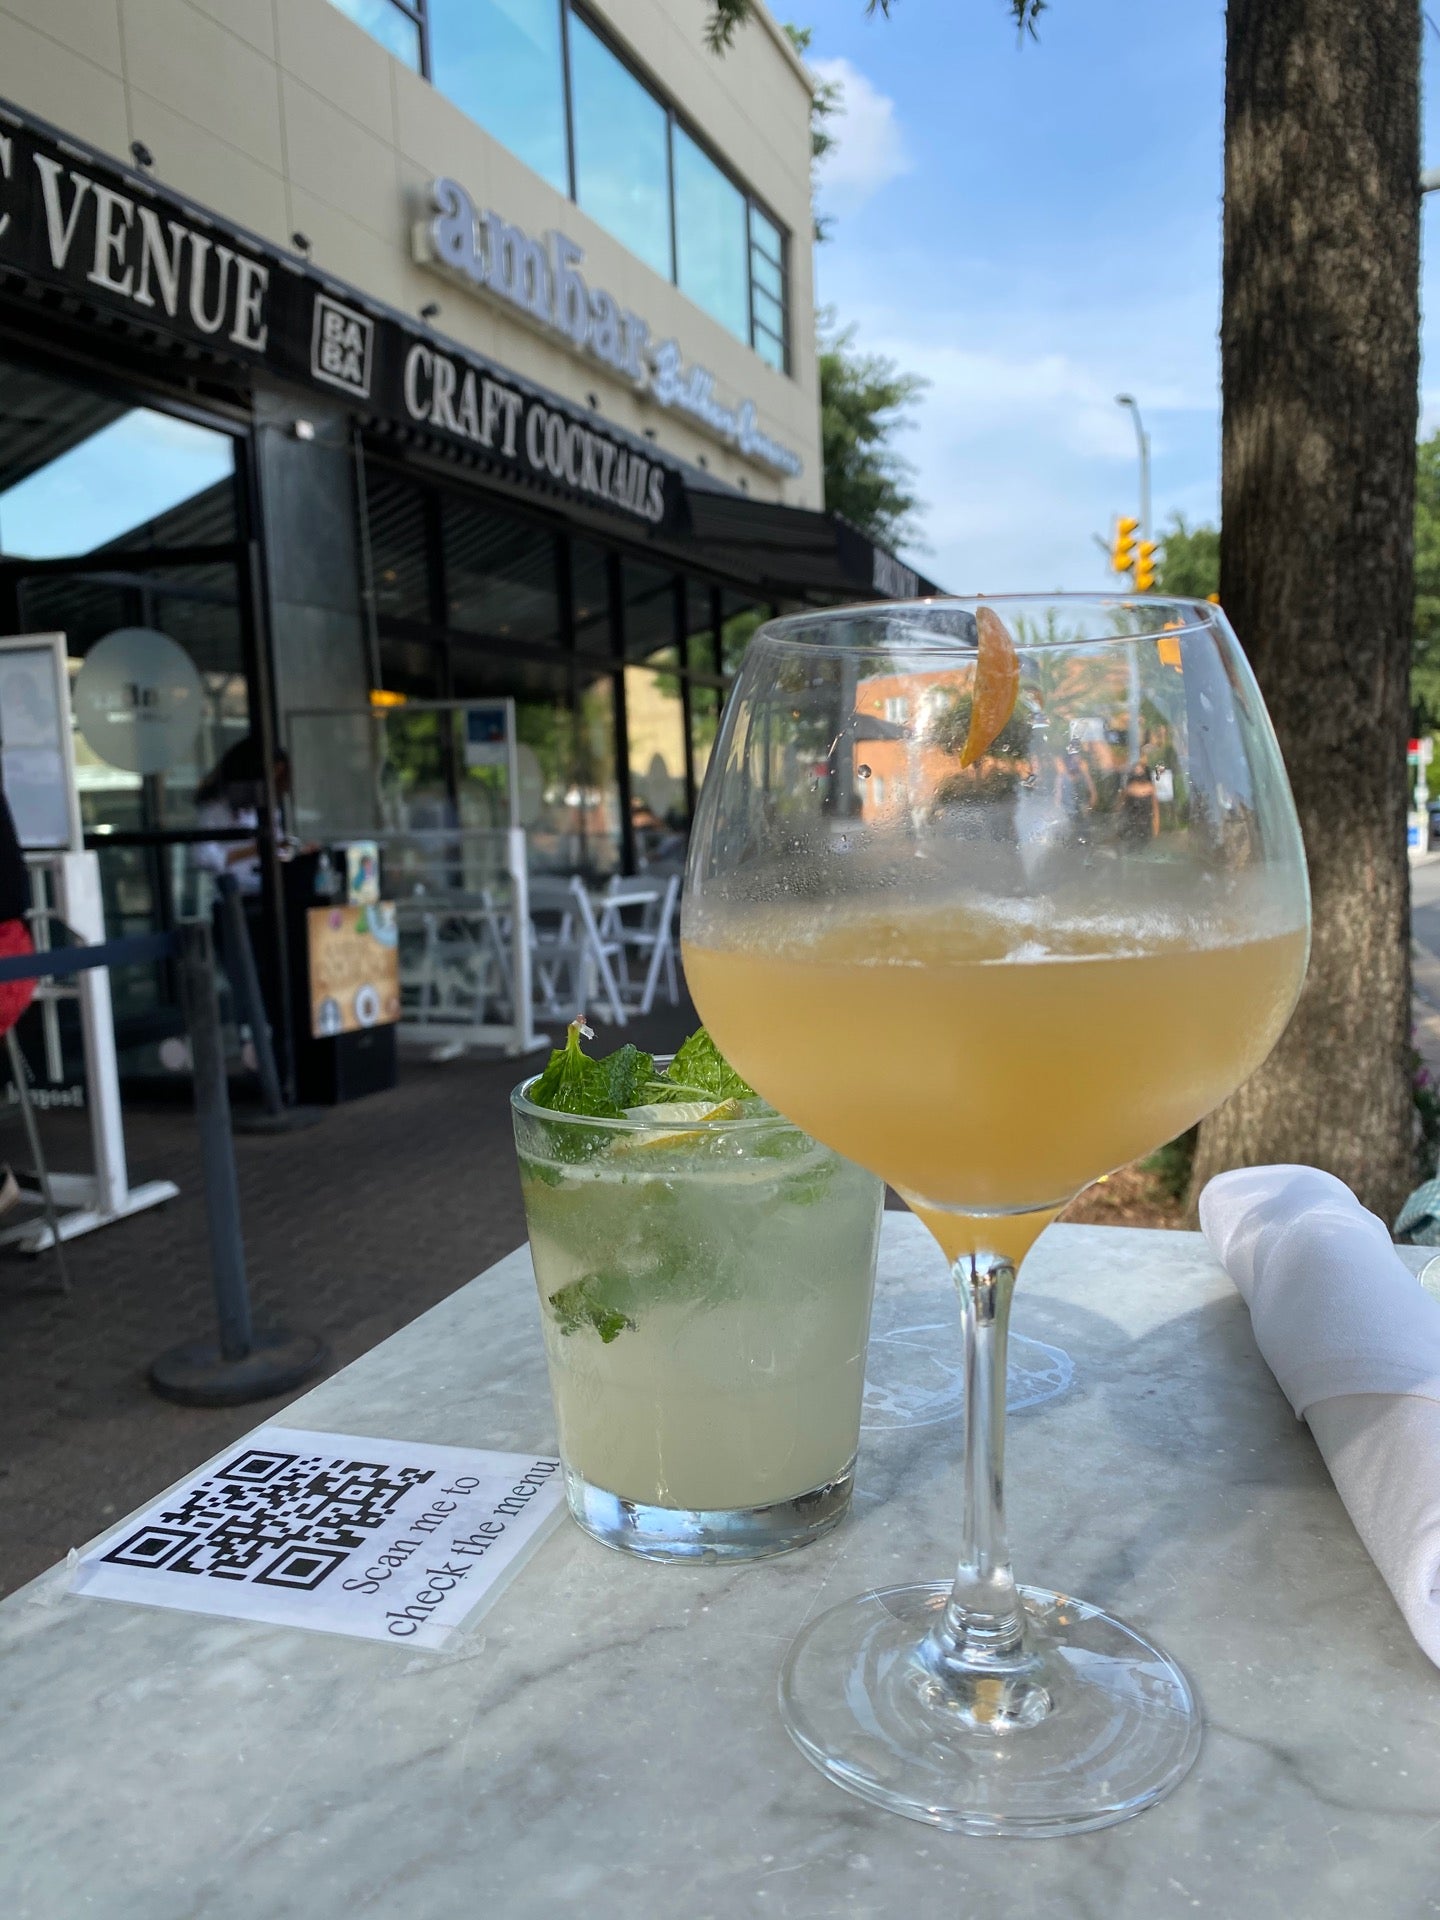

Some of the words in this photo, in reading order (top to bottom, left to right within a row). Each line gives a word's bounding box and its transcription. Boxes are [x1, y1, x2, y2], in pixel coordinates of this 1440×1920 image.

[33, 152, 269, 353] VENUE
[321, 340, 362, 383] BA
[323, 310, 363, 356] BA
[404, 344, 523, 457] CRAFT
[525, 403, 665, 522] COCKTAILS
[342, 1536, 423, 1594] Scan
[410, 1499, 457, 1533] me
[440, 1476, 480, 1495] to
[385, 1561, 473, 1636] check
[450, 1519, 505, 1556] the
[493, 1460, 560, 1517] menu
